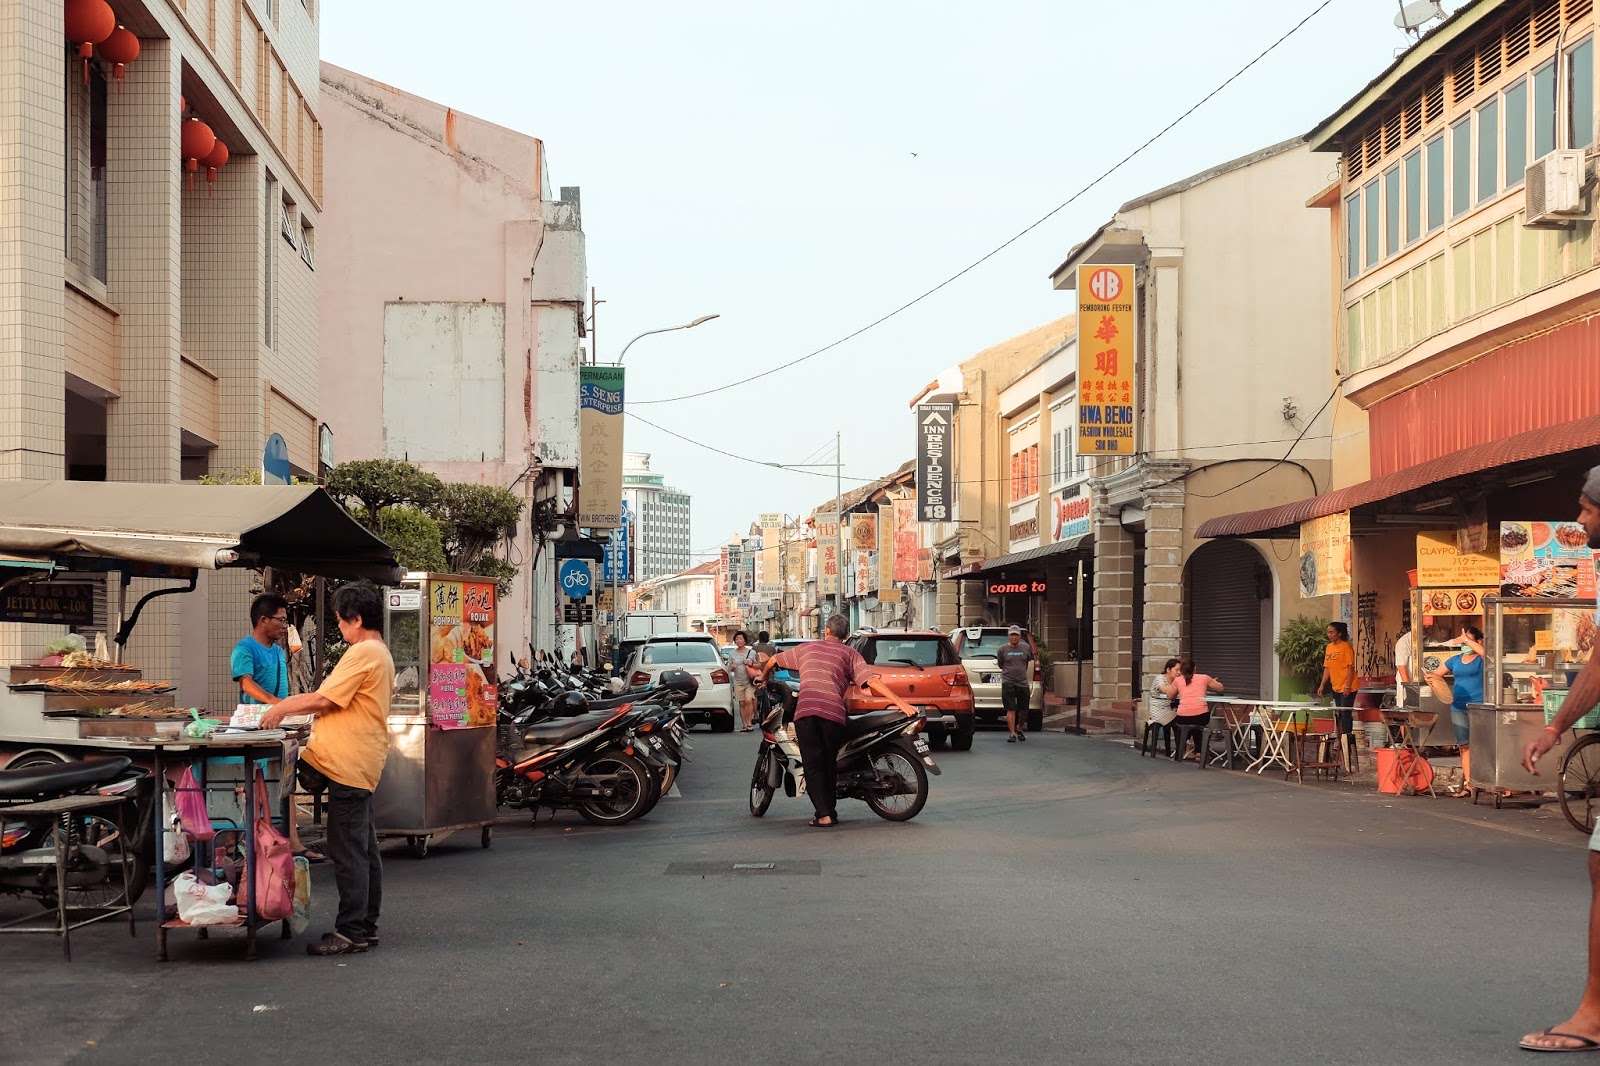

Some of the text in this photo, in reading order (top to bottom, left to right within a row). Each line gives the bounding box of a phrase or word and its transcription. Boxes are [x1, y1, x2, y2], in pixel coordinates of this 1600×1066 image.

[1094, 315, 1119, 377] 華明
[580, 371, 623, 381] PERNIAGAAN
[592, 386, 620, 403] SENG
[1082, 392, 1130, 403] 有限公司
[580, 398, 623, 412] ENTERPRISE
[1080, 405, 1133, 424] HWA BENG
[924, 426, 945, 434] INN
[1080, 426, 1133, 438] FASHION WHOLESALE
[1095, 440, 1105, 450] SDN
[927, 435, 943, 505] RESIDENCE
[924, 505, 946, 519] 18
[579, 514, 590, 523] WIN
[1453, 557, 1487, 565] バクテー
[1506, 573, 1538, 585] Satay
[990, 581, 1046, 593] come to
[7, 597, 37, 609] JETTY
[41, 599, 60, 611] LOK
[70, 600, 87, 612] LOK
[433, 616, 446, 626] POH
[471, 612, 490, 622] ROJAK
